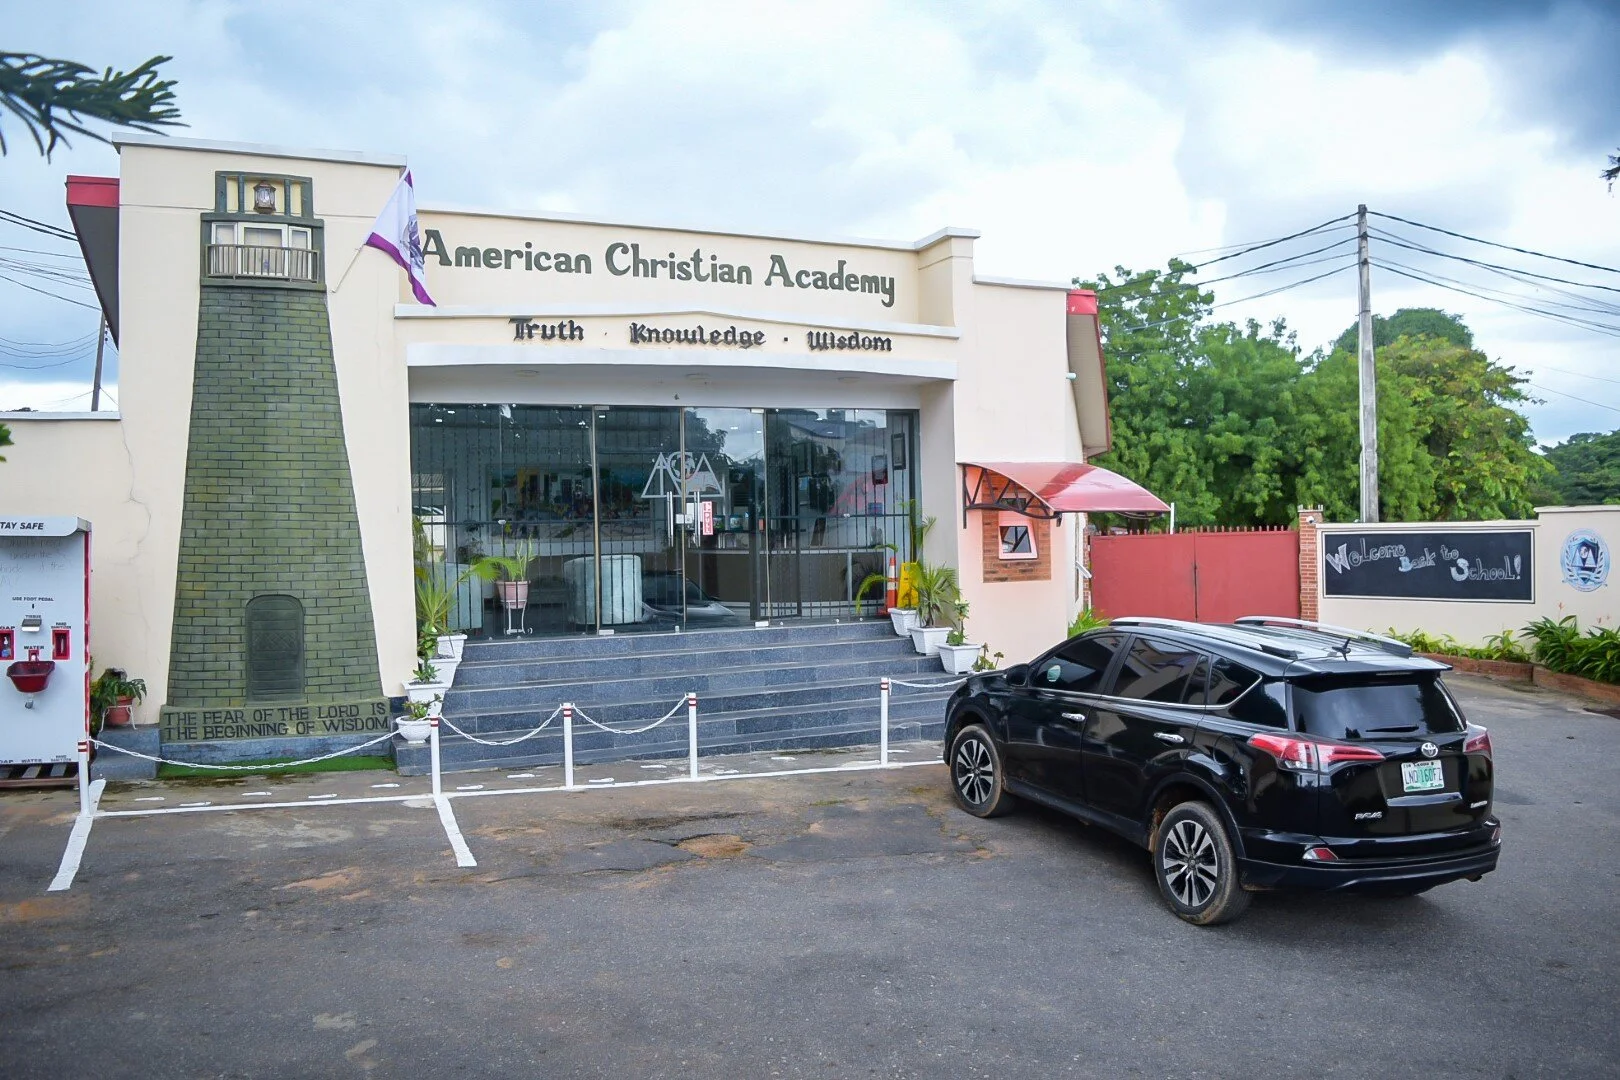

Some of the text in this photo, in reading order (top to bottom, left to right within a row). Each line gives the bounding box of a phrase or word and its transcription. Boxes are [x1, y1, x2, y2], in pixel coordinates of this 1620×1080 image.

[422, 229, 895, 307] American Christian Academy
[508, 316, 893, 353] Truth Knowledge Wisdom
[19, 522, 44, 530] SAFE
[1398, 549, 1436, 573] Back
[1440, 544, 1459, 560] to
[164, 701, 386, 726] THE FEAR OF THE LORD IS
[164, 716, 389, 740] THE BEGINNING OF WISDOM
